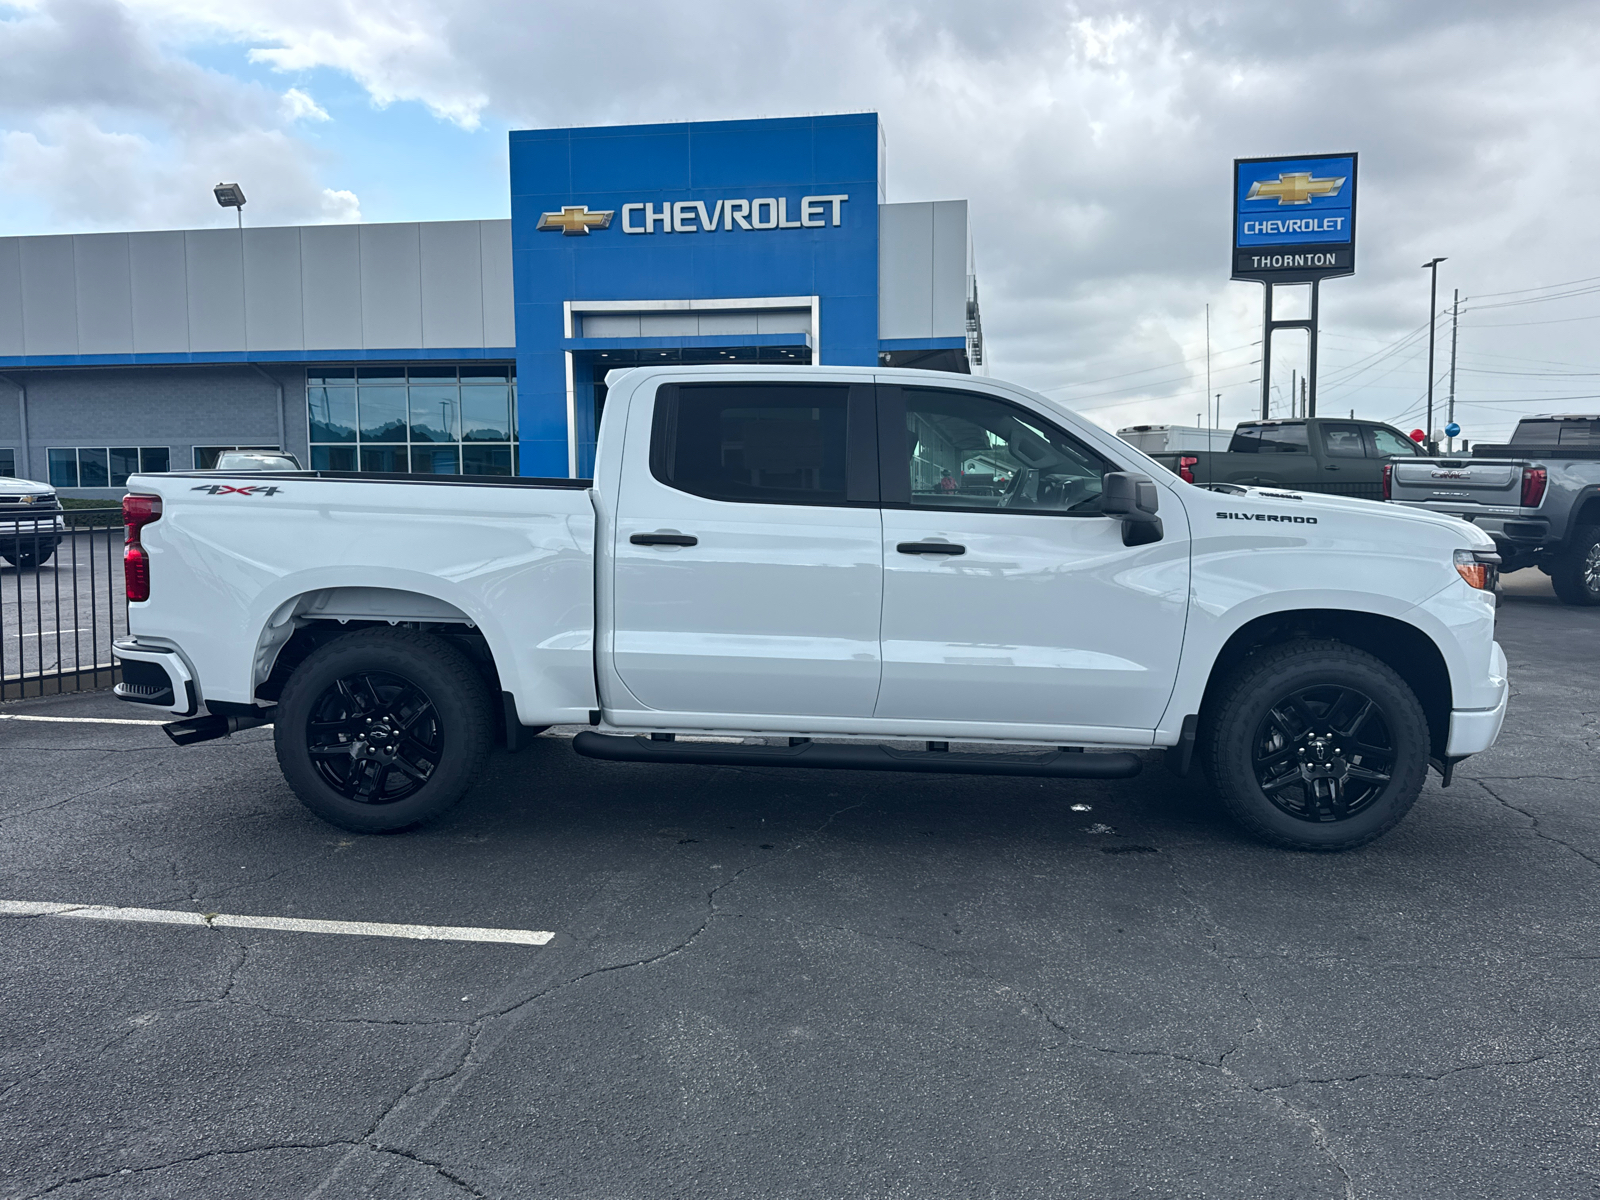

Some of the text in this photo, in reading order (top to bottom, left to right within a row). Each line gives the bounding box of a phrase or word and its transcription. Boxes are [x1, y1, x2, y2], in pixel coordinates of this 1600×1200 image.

[622, 194, 848, 233] CHEVROLET
[1244, 217, 1345, 234] CHEVROLET
[1252, 253, 1336, 268] THORNTON
[1431, 469, 1471, 480] GMC
[1216, 512, 1318, 525] SILVERADO
